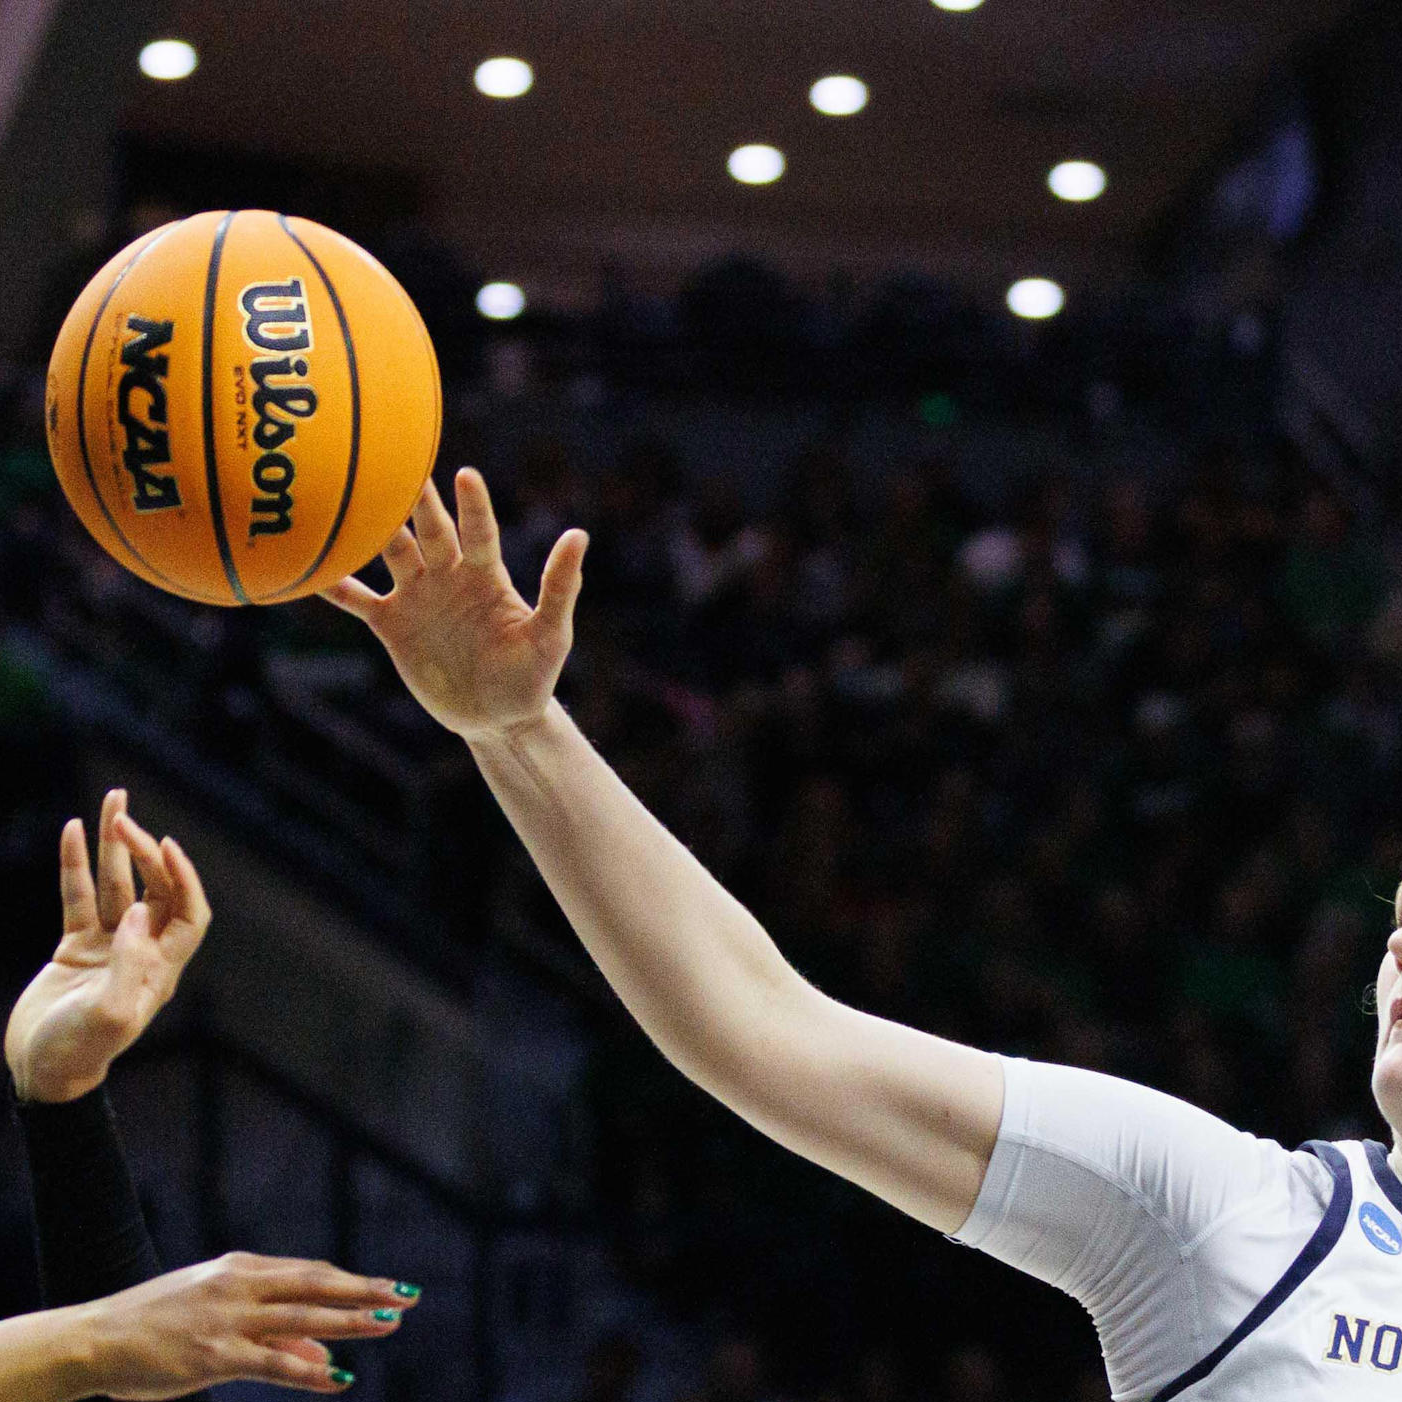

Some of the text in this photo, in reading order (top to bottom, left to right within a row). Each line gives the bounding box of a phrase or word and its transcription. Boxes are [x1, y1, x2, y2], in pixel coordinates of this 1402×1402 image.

[118, 314, 183, 513] NCAA
[238, 277, 318, 536] Wilson
[1361, 1213, 1401, 1253] NCAA
